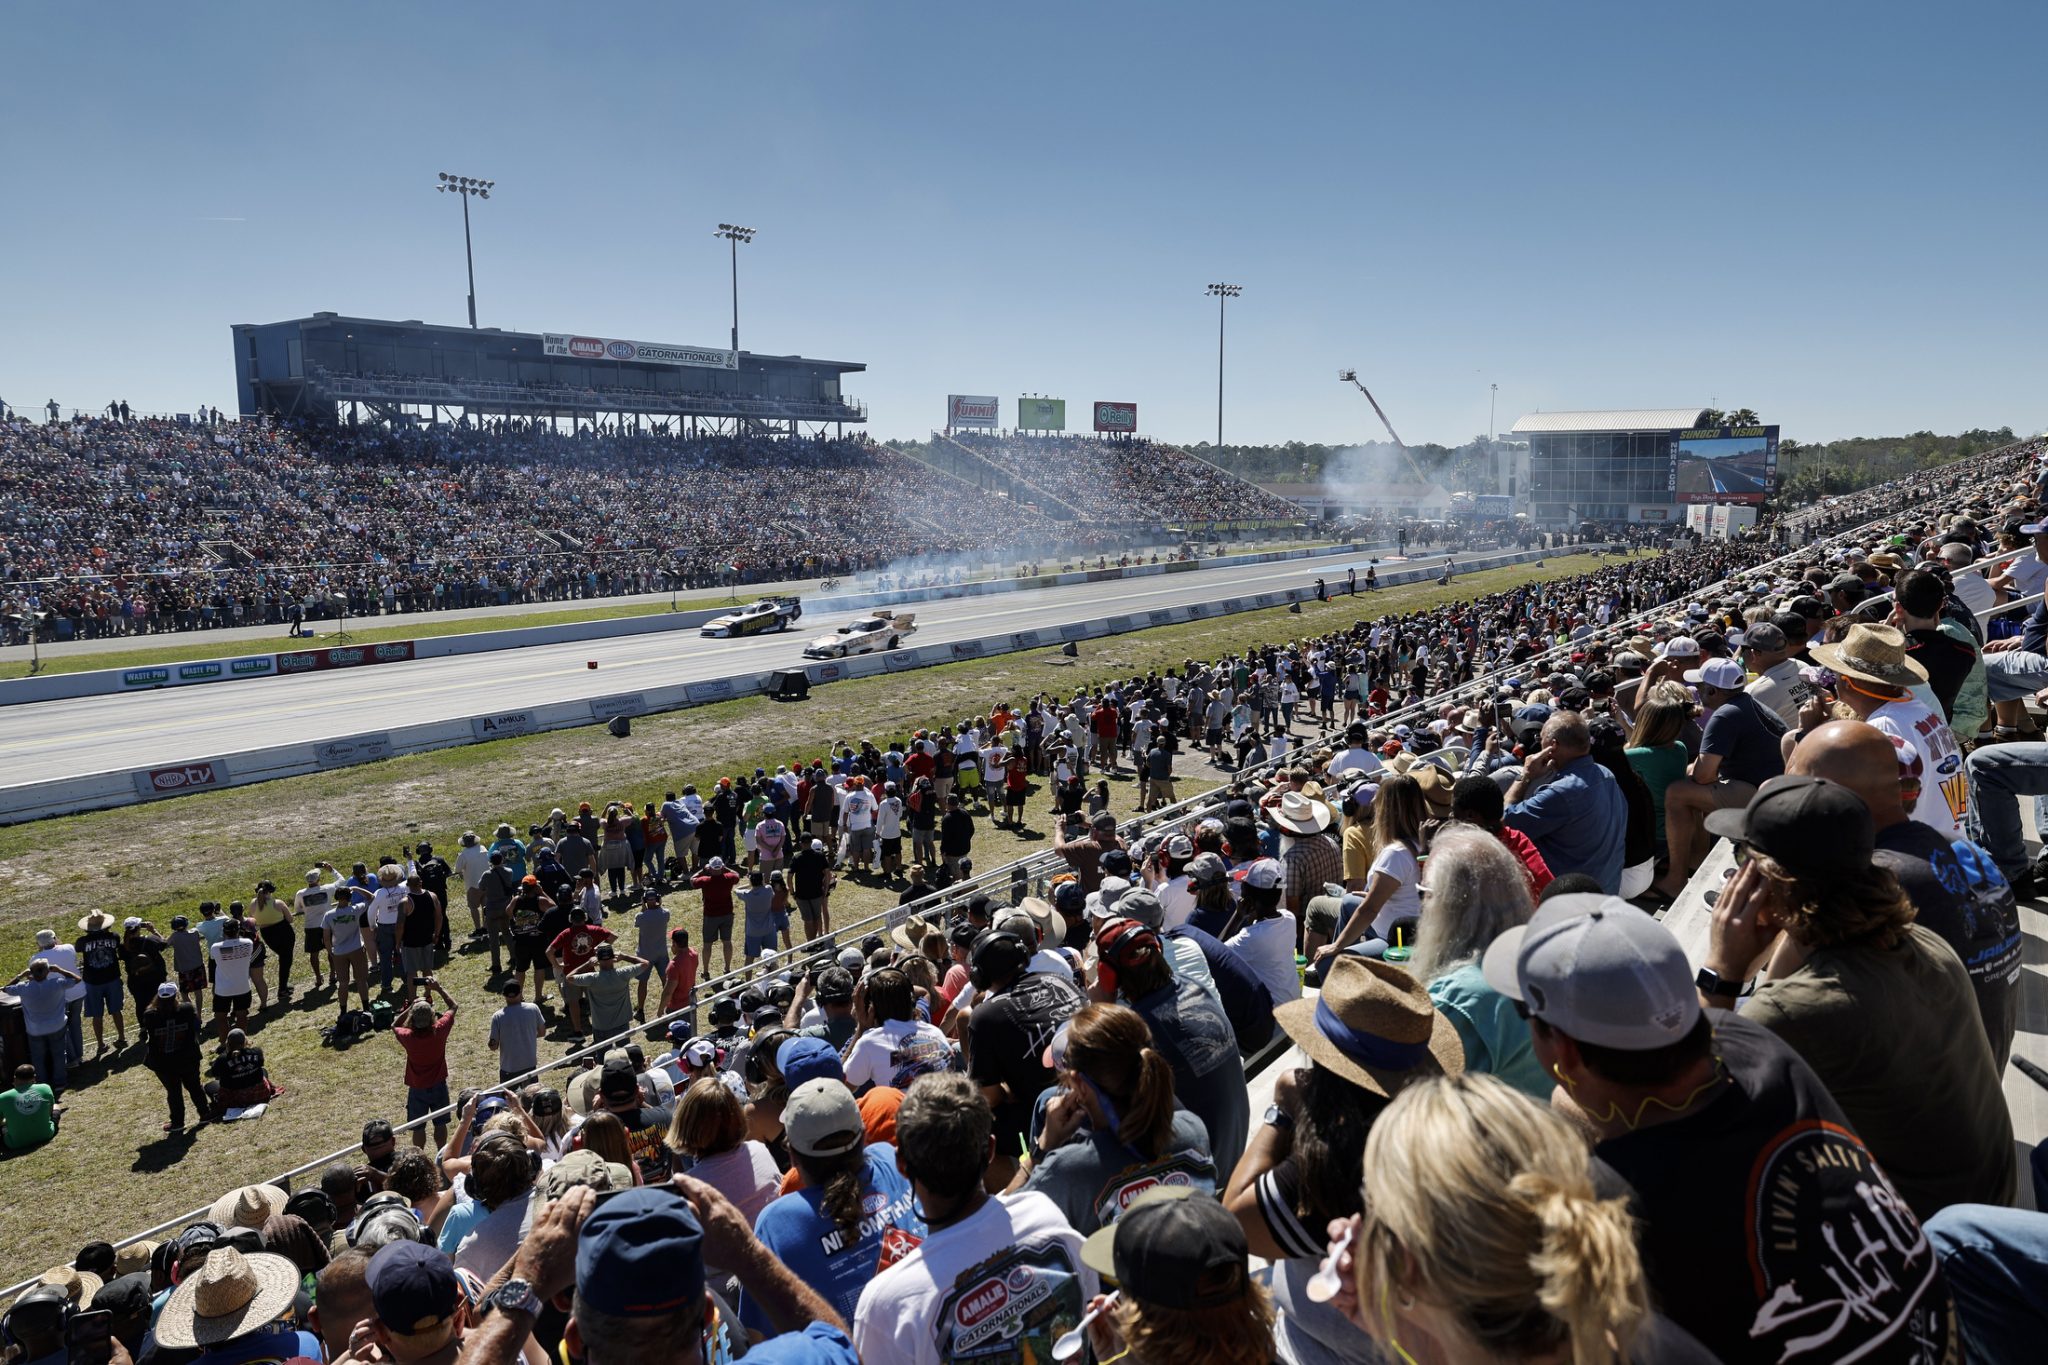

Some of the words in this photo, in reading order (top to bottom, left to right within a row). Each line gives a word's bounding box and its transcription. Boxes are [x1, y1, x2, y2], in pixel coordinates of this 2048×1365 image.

[545, 335, 564, 345] Home
[547, 345, 555, 354] of
[556, 346, 568, 355] the
[572, 341, 603, 353] AMALIE
[609, 343, 633, 357] NHRA
[637, 346, 723, 364] GATORNATIONALS
[952, 395, 998, 424] SUMMIT
[1099, 405, 1134, 426] O'Reilly
[1680, 429, 1721, 439] SUNOCO
[1730, 427, 1766, 437] VISION
[1478, 508, 1508, 516] WORLD
[181, 665, 203, 675] WASTE
[206, 664, 219, 673] PRO
[234, 661, 255, 669] WASTE
[256, 659, 269, 668] PRO
[127, 672, 151, 681] WASTE
[152, 669, 166, 679] PRO
[498, 714, 527, 725] AMKUS
[227, 1054, 258, 1068] ELITE
[1770, 1164, 1801, 1251] LIVIN'
[1796, 1144, 1863, 1173] SALTY
[961, 1284, 1006, 1322] AMALIE
[957, 1280, 1049, 1349] GATORNATIONALS
